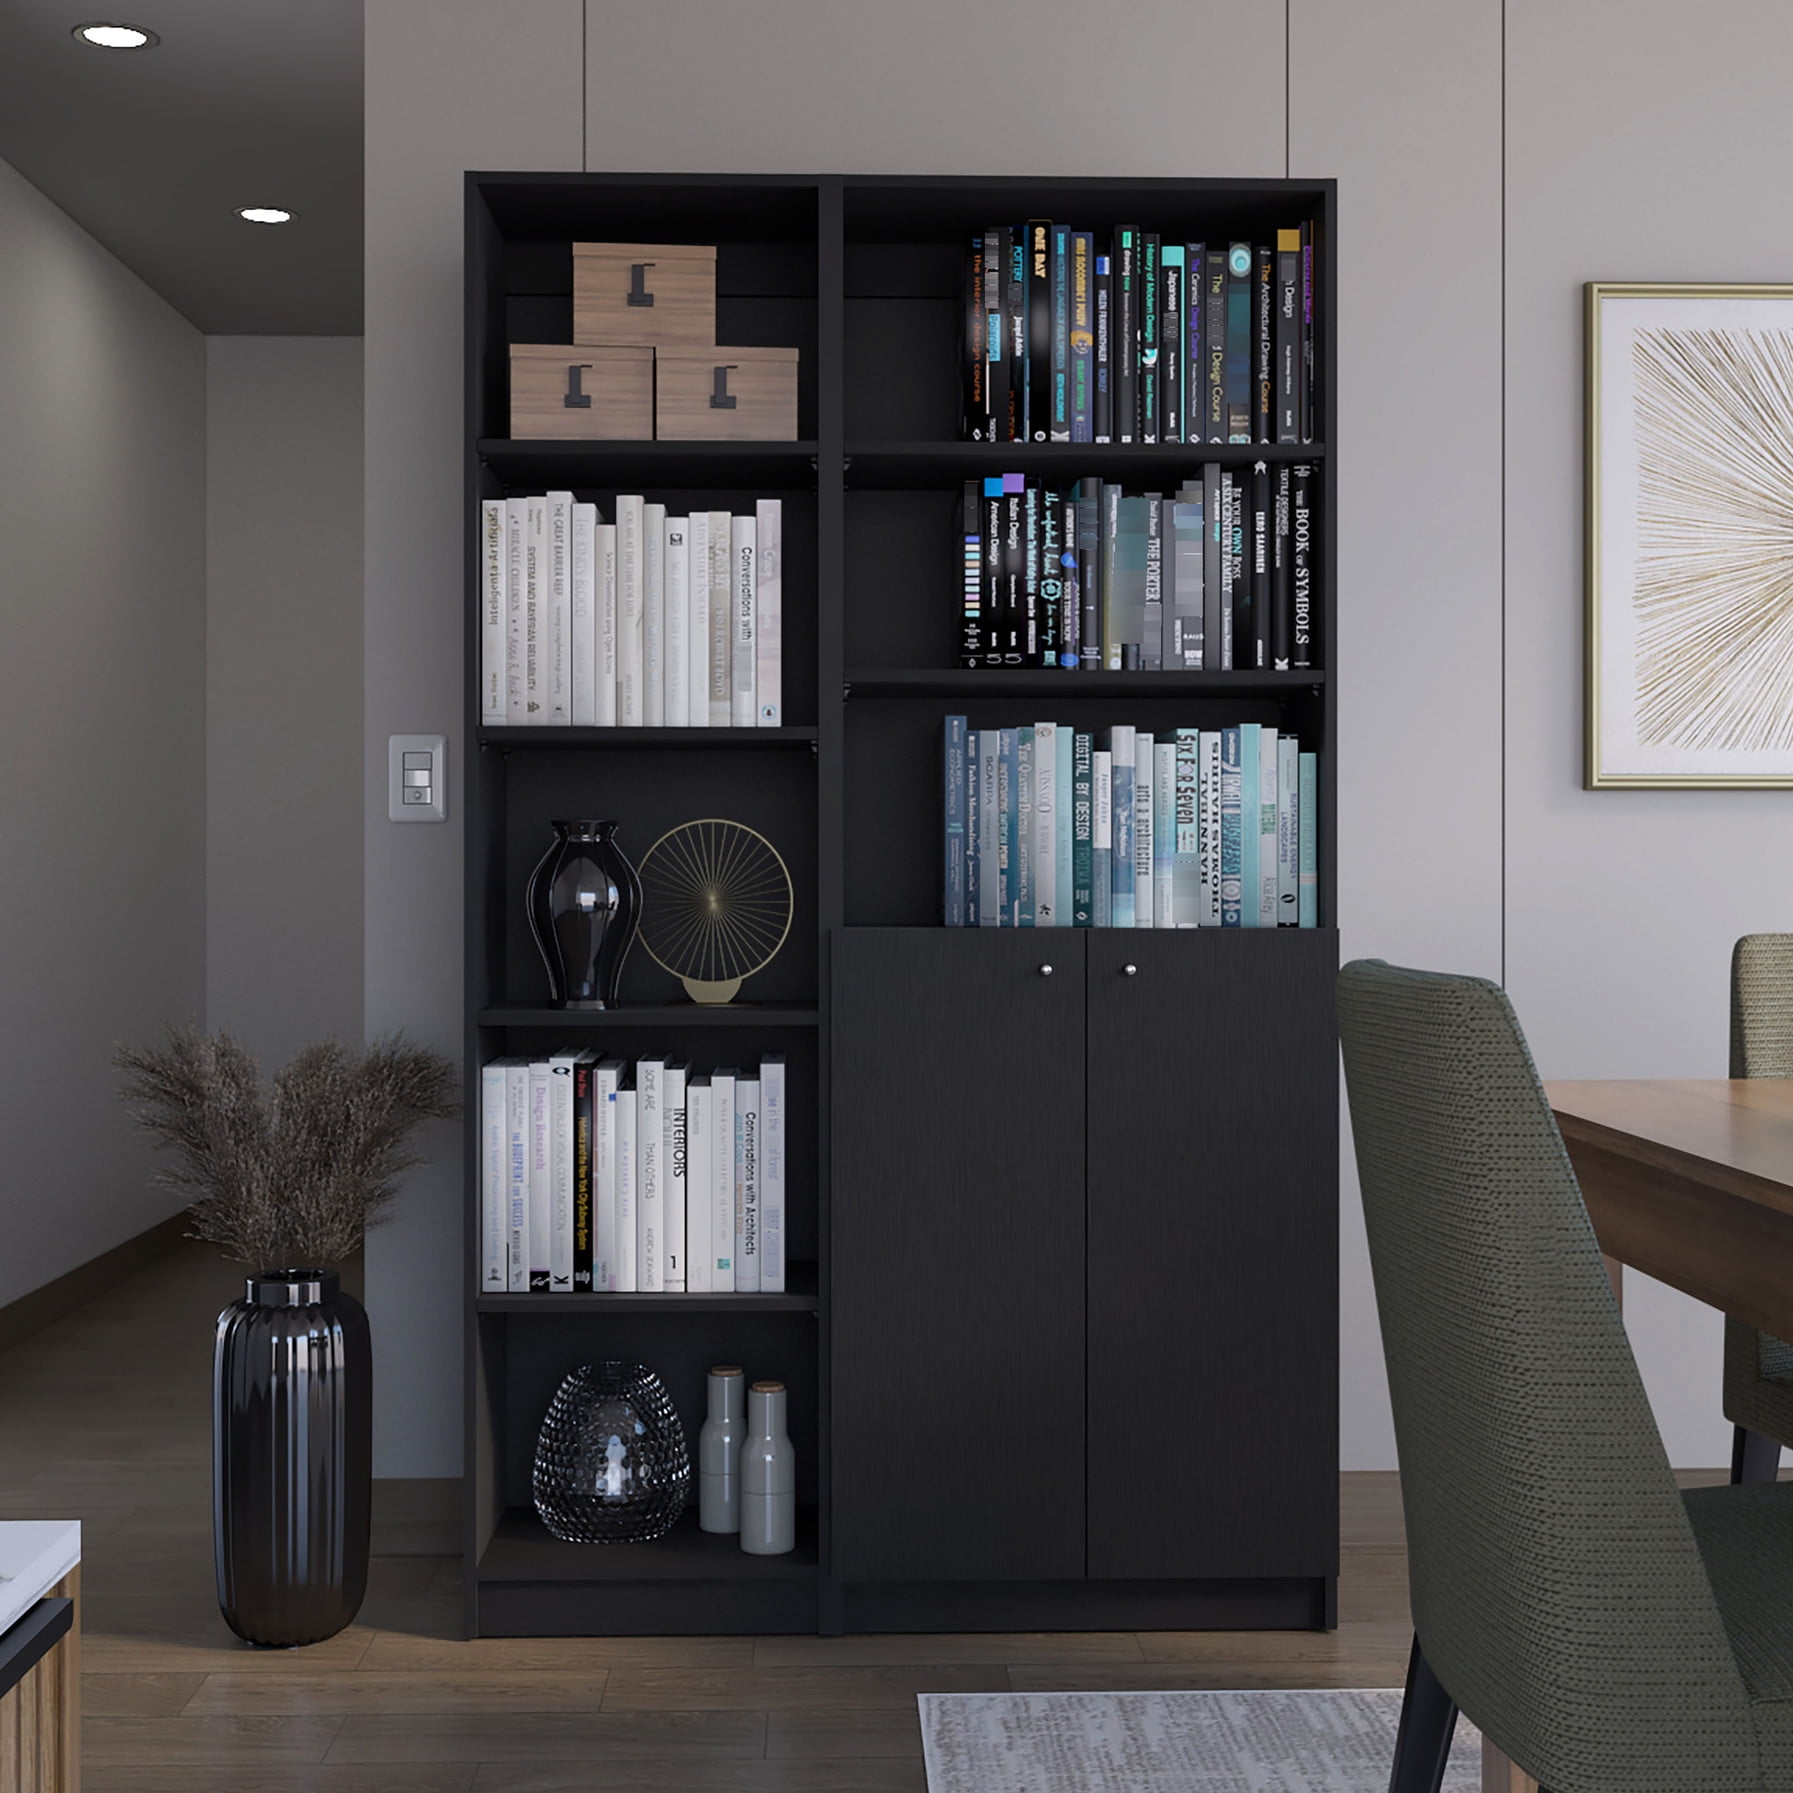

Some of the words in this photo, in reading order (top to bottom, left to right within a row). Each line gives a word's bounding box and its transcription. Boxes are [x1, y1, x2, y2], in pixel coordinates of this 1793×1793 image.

[1034, 226, 1046, 252] ONE
[973, 254, 982, 273] the
[1014, 246, 1024, 282] POTTERY
[1034, 253, 1046, 278] DAY
[1144, 243, 1155, 271] History
[1261, 263, 1272, 282] The
[1144, 271, 1155, 281] of
[1166, 270, 1179, 311] Japanese
[1191, 272, 1201, 306] Ceramics
[1211, 273, 1224, 294] The
[973, 276, 982, 319] interior
[1146, 282, 1155, 314] Modern
[1261, 282, 1271, 340] Architectural
[1282, 286, 1296, 318] Design
[971, 322, 982, 360] design
[1144, 314, 1155, 343] Design
[1209, 352, 1223, 386] Design
[1258, 341, 1271, 380] Drawing
[974, 363, 982, 402] course
[1261, 380, 1271, 414] Course
[1212, 386, 1223, 423] Course
[553, 503, 565, 518] THE
[990, 500, 1000, 538] American
[553, 518, 565, 545] GREAT
[1007, 521, 1020, 550] Design
[1222, 503, 1233, 554] CENTURY
[1232, 527, 1243, 555] OWN
[1295, 508, 1310, 553] BOOK
[526, 545, 537, 580] SYSTEM
[553, 545, 565, 577] BARRIER
[988, 538, 1000, 567] Design
[1147, 537, 1161, 561] THE
[526, 580, 537, 600] AND
[739, 546, 753, 618] Conversations
[1145, 560, 1161, 602] PORTER
[1222, 553, 1233, 594] FAMILY
[1295, 567, 1310, 645] SYMBOLS
[741, 618, 753, 641] with
[1075, 734, 1090, 778] DIGITAL
[1176, 734, 1197, 755] Six
[968, 764, 977, 796] Fashion
[985, 755, 995, 806] SCARPA
[1075, 782, 1090, 796] BY
[1100, 773, 1109, 799] Jasper
[1075, 800, 1090, 841] DESIGN
[1176, 786, 1197, 825] Seven
[966, 796, 977, 857] Merchandising
[1200, 772, 1208, 885] HANNIBAL
[644, 1068, 656, 1092] SOME
[533, 1087, 547, 1122] Design
[644, 1093, 656, 1112] ARE
[535, 1124, 547, 1171] Research
[644, 1142, 656, 1165] THAN
[673, 1107, 686, 1179] INTERIORS
[745, 1111, 757, 1181] Conversations
[644, 1166, 656, 1200] OTHERS
[745, 1183, 757, 1205] with
[745, 1206, 757, 1256] Architects
